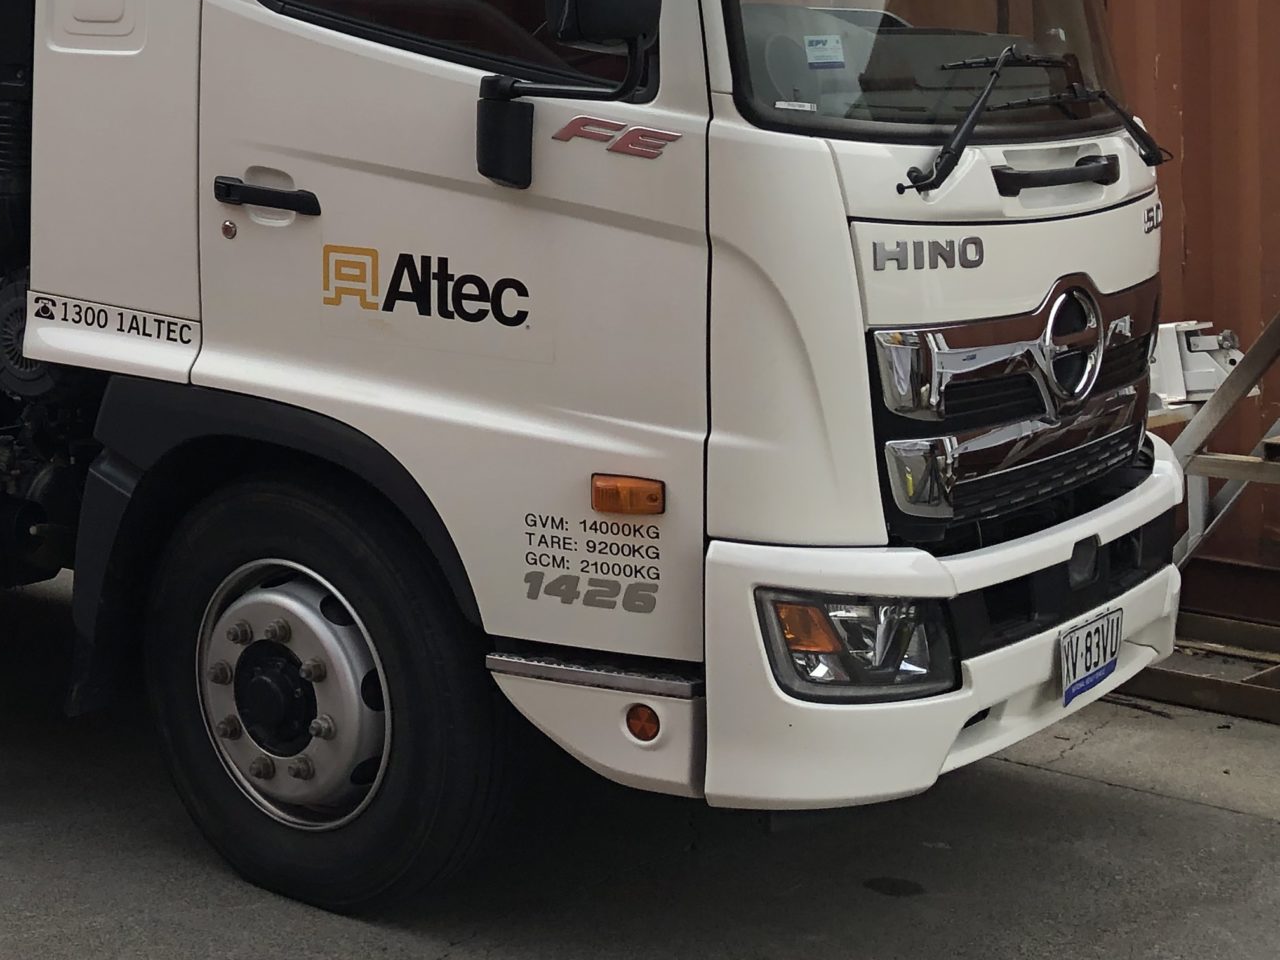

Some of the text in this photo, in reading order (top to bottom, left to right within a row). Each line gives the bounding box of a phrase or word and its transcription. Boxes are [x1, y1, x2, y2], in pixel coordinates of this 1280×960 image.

[551, 114, 682, 160] FE
[872, 236, 984, 271] HINO
[382, 253, 530, 327] Altec
[61, 302, 192, 345] 1300 1ALTEC
[524, 513, 660, 539] GVM: 14000KG
[525, 532, 661, 560] TARE: 9200KG
[525, 551, 660, 580] GCM: 21000KG
[524, 570, 659, 614] 1426
